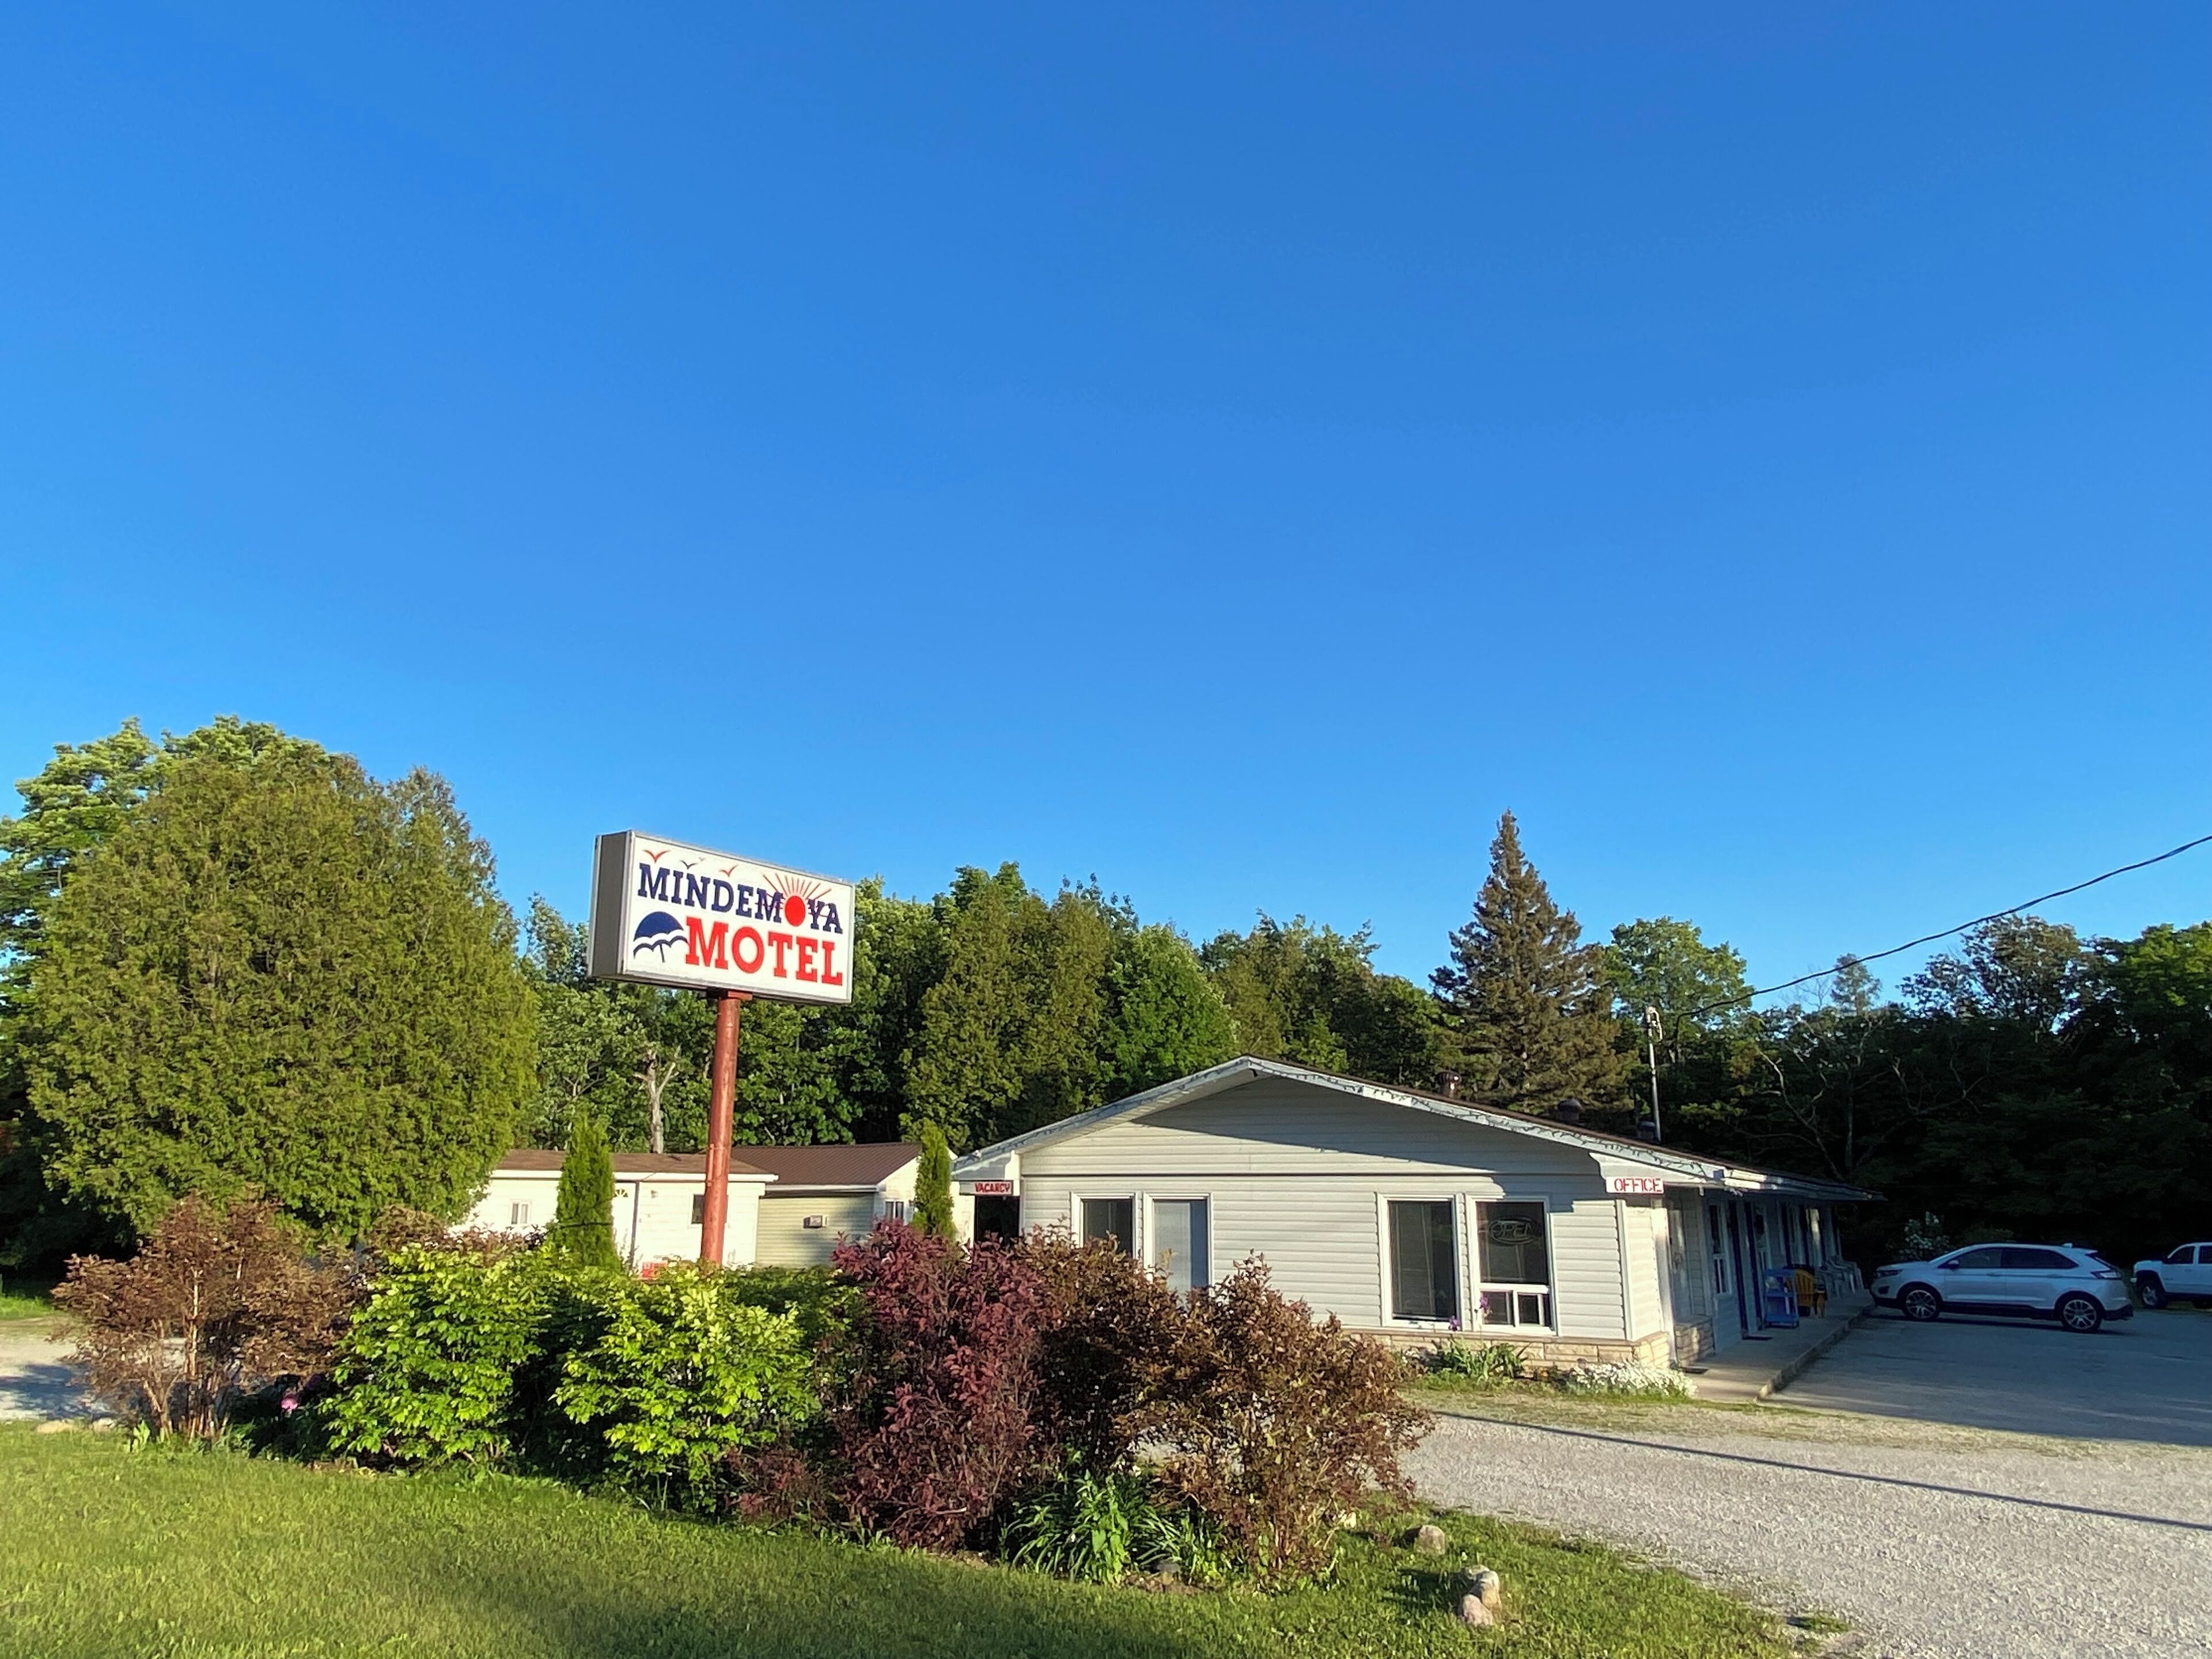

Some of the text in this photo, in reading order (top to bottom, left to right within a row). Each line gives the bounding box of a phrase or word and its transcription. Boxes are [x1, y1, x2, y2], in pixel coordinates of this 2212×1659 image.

[638, 863, 843, 934] MINDEMOYA
[685, 916, 843, 986] MOTEL
[975, 1183, 1010, 1192] VACANCY
[1614, 1177, 1661, 1192] OFFICE
